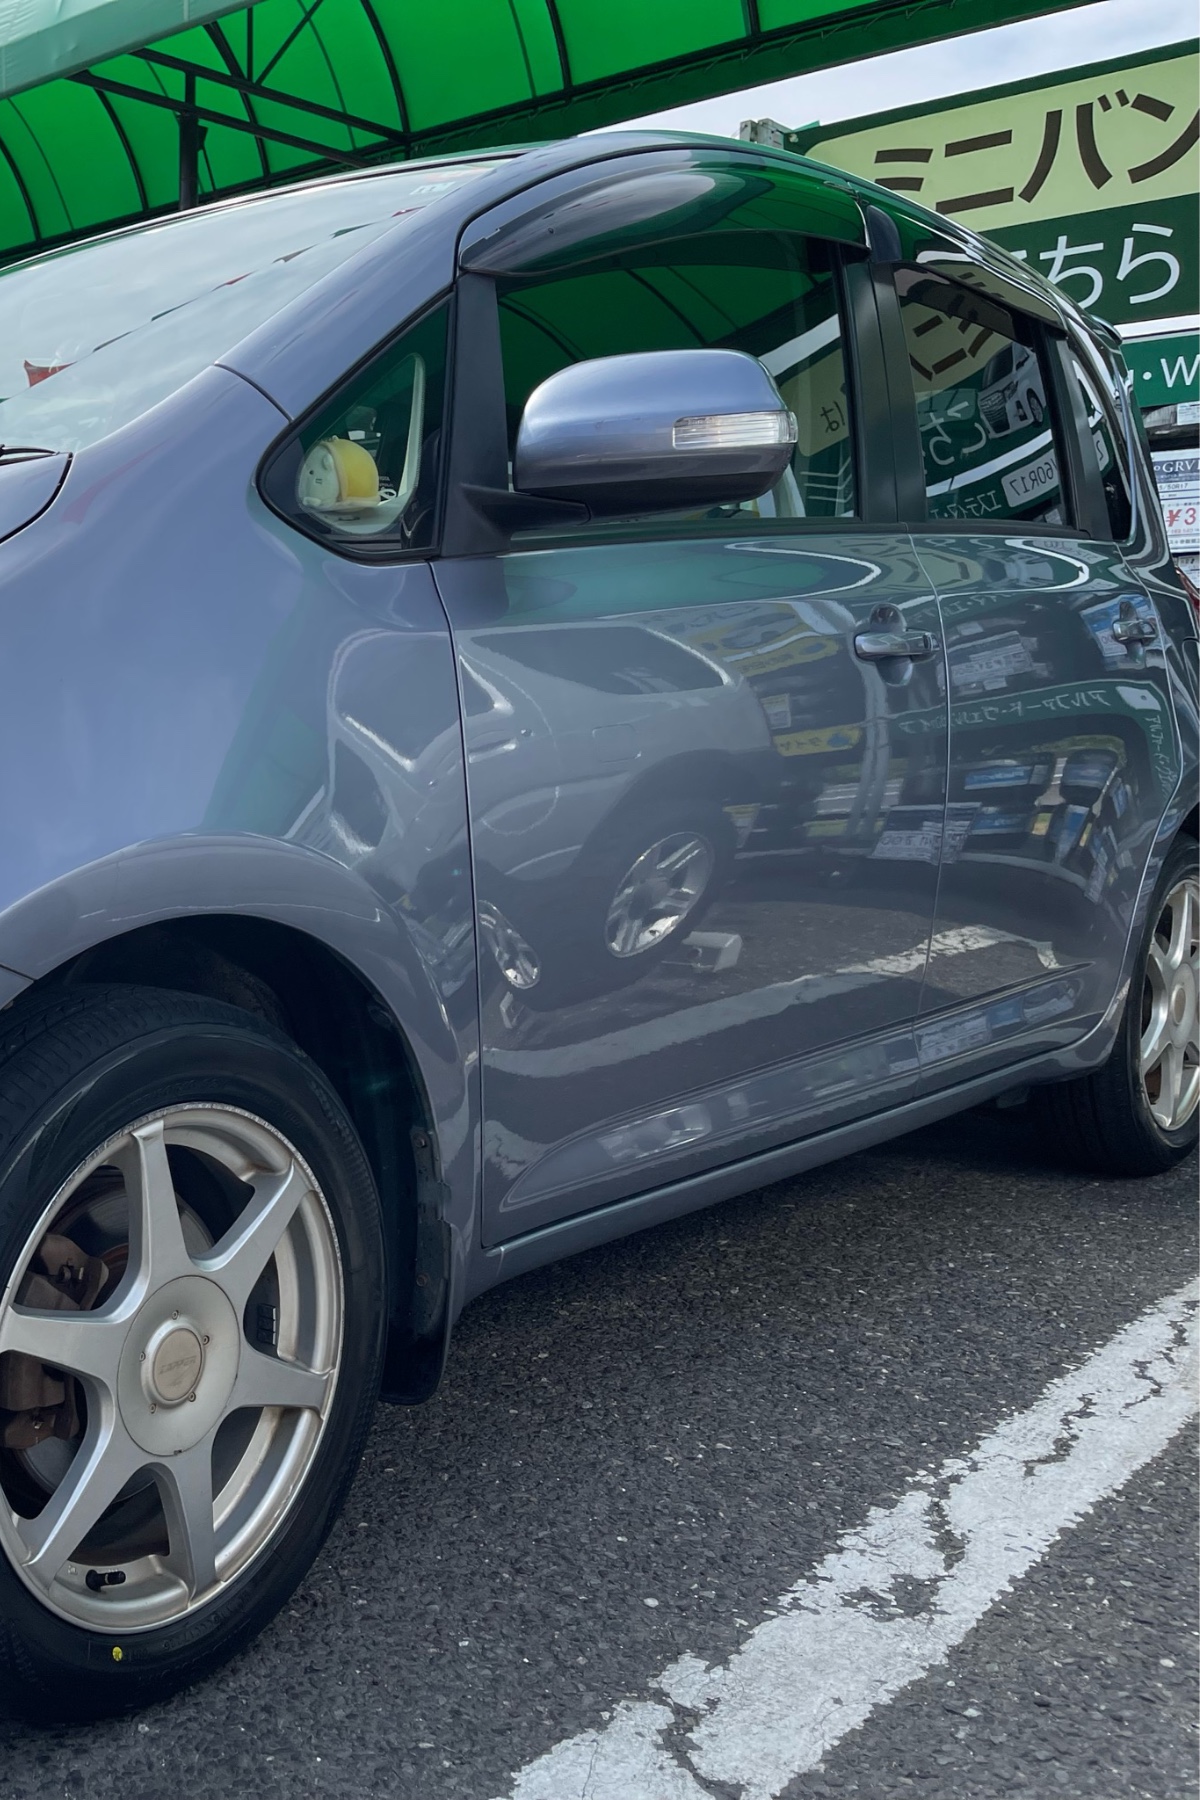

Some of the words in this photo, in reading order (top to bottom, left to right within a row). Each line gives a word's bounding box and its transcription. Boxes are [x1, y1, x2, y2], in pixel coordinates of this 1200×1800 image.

[874, 88, 1200, 215] ミニバン
[1011, 223, 1180, 310] ちら
